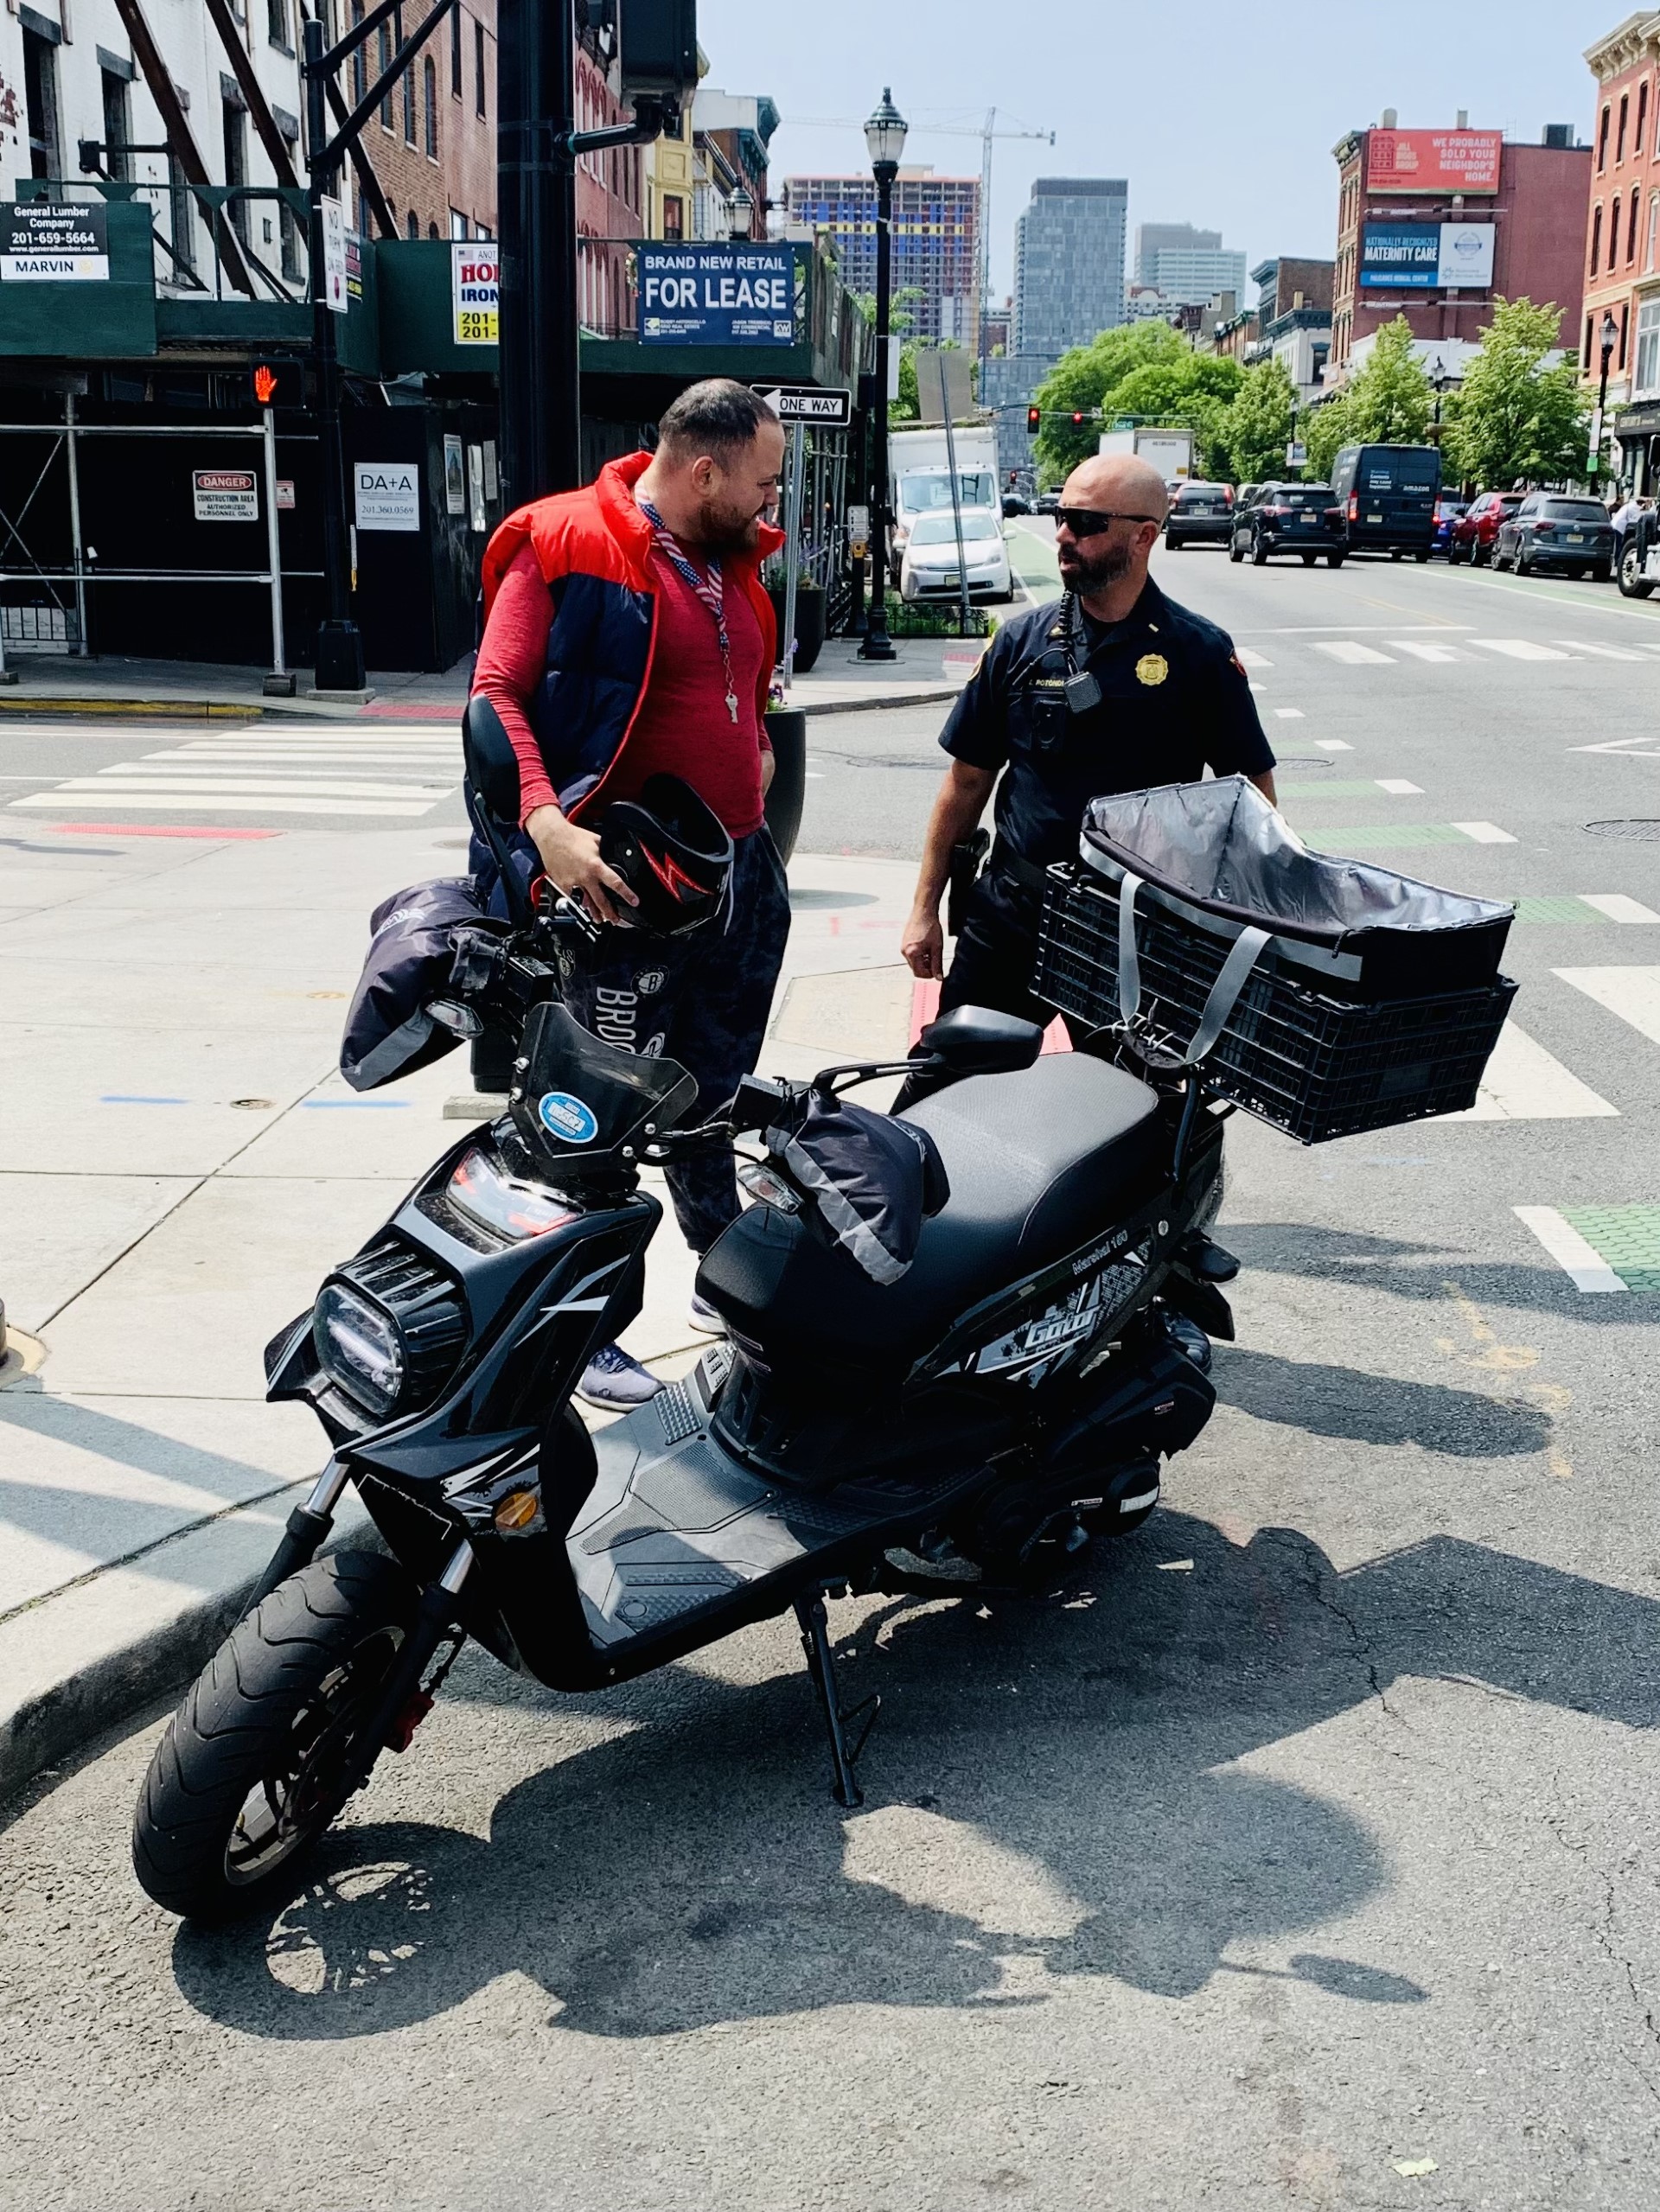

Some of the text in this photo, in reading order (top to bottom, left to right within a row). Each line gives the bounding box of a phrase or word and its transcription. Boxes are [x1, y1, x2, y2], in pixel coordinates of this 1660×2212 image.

[1432, 137, 1497, 148] WE PROBABLY
[1440, 149, 1496, 159] SOLD YOUR
[1440, 160, 1495, 170] NEIGHBOR'S
[14, 206, 90, 217] General Lumber
[29, 218, 74, 230] Company
[11, 232, 95, 245] 201-659-5664
[9, 245, 99, 253] www.generallumber.com
[1364, 246, 1438, 262] MATERNITY CARE
[16, 260, 73, 272] MARVIN
[645, 256, 787, 271] BRAND NEW RETAIL
[462, 288, 500, 302] IRON
[645, 277, 787, 309] FOR LEASE
[780, 398, 839, 413] ONE WAY
[203, 476, 246, 488] DANGER
[361, 475, 412, 491] DA+A
[197, 494, 254, 503] CONSTRUCTION AREA
[1024, 1304, 1102, 1349] Gator
